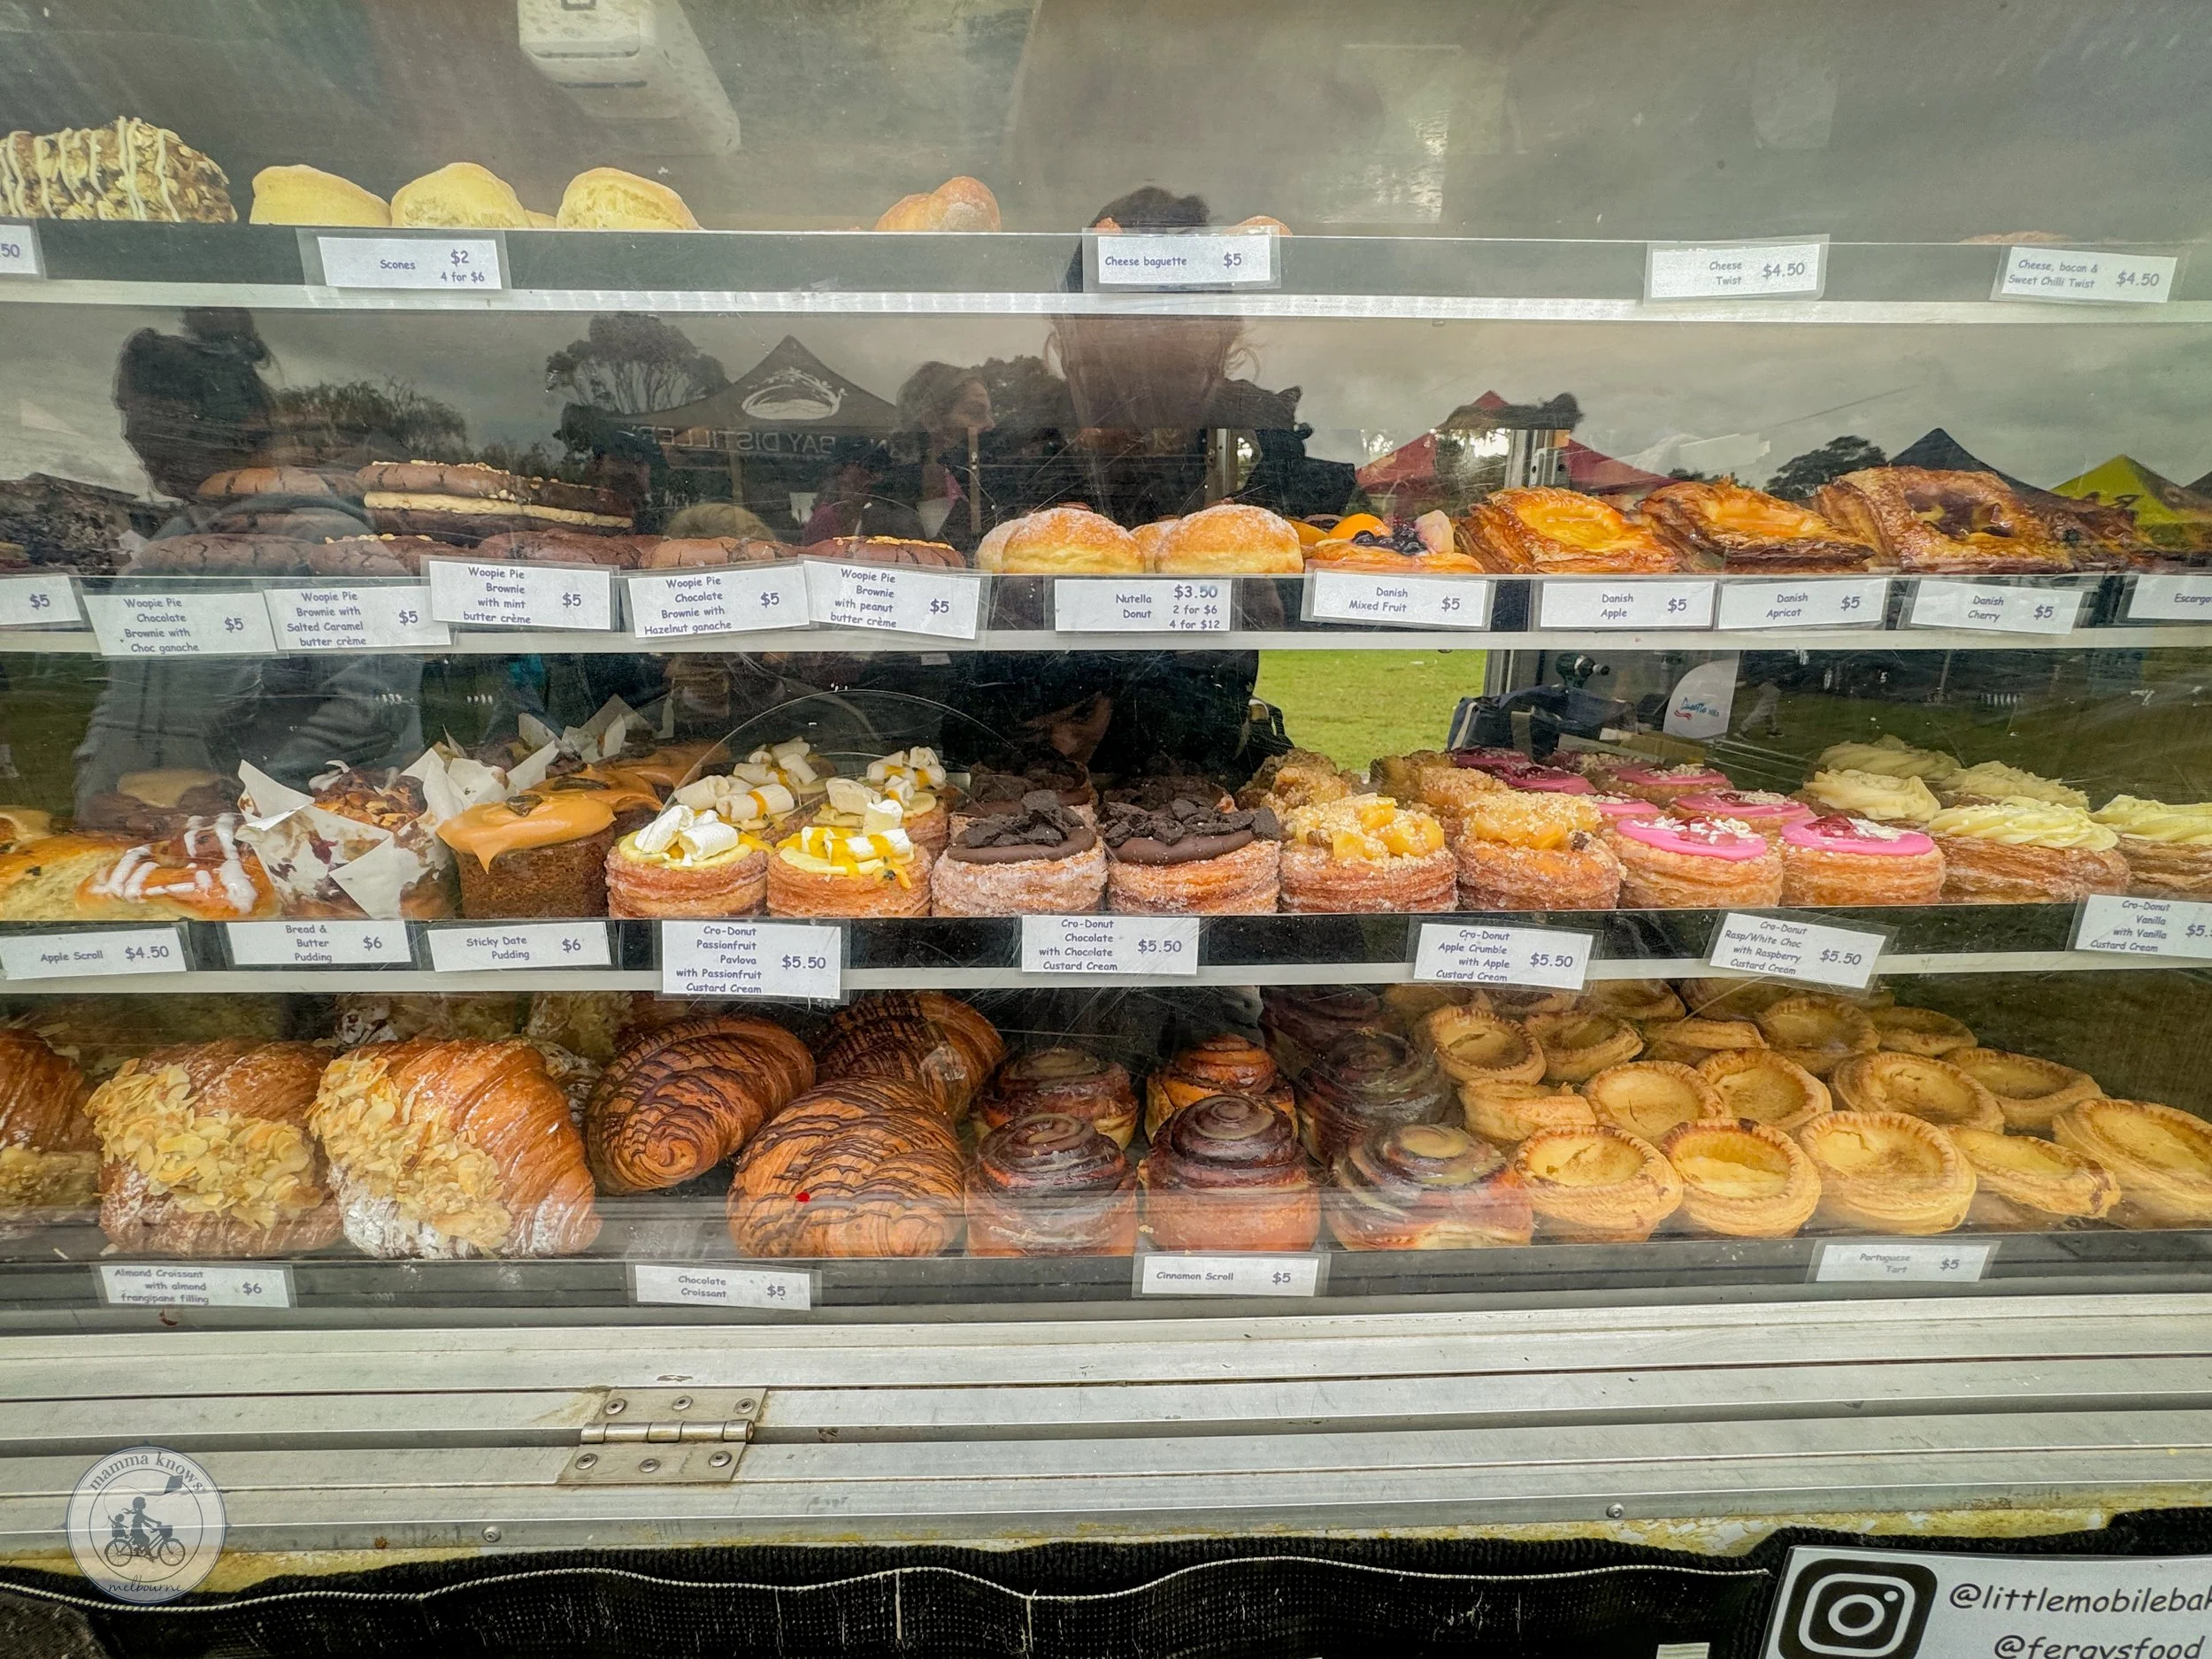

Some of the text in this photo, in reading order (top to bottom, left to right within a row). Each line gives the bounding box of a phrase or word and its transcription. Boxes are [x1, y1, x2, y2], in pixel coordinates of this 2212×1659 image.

[380, 259, 415, 270] Scones
[450, 250, 469, 267] $2
[1105, 256, 1187, 268] Cheese baguette
[1224, 252, 1241, 269] $5
[1709, 261, 1742, 271] Cheese
[1762, 262, 1805, 280] $4.50
[2018, 259, 2098, 273] Cheese, bacon &
[441, 271, 485, 283] 4 for $6
[1716, 276, 1741, 285] Twist
[2008, 274, 2095, 288] Sweet Chilli Twist
[2116, 271, 2159, 287] $4.50
[468, 567, 525, 580] Woopie Pie
[841, 568, 895, 583] Woopie Pie
[487, 582, 525, 594] Brownie
[665, 576, 721, 589] Woopie Pie
[301, 591, 357, 603] Woopie Pie
[675, 591, 723, 603] Chocolate
[856, 585, 894, 597] Brownie
[1174, 584, 1217, 601] $3.50
[1376, 587, 1408, 597] Danish
[29, 594, 50, 610] $5
[123, 597, 182, 610] Woopie Pie
[478, 598, 526, 609] with mint
[563, 592, 581, 608] $5
[761, 592, 780, 608] $5
[1116, 594, 1152, 603] Nutella
[1441, 596, 1460, 612] $5
[1602, 593, 1633, 603] Danish
[1777, 593, 1808, 603] Danish
[1840, 595, 1860, 611] $5
[1972, 595, 2004, 606] Danish
[2174, 593, 2212, 605] Escargo
[835, 598, 894, 612] with peanut
[930, 598, 949, 614] $5
[1173, 604, 1217, 616] 2 for $6
[1349, 600, 1407, 612] Mixed Fruit
[1668, 598, 1686, 613] $5
[137, 613, 187, 622] Chocolate
[296, 606, 361, 617] Brownie with
[464, 611, 531, 624] butter crème
[662, 605, 725, 618] Brownie with
[1124, 609, 1151, 618] Donut
[1601, 608, 1627, 619] Apple
[1766, 609, 1801, 620] Apricot
[1968, 610, 2001, 623] Cherry
[2034, 604, 2054, 619] $5
[399, 610, 418, 626] $5
[831, 611, 896, 627] butter crème
[225, 617, 243, 633] $5
[288, 621, 364, 632] Salted Caramel
[645, 620, 732, 635] Hazelnut ganache
[1180, 619, 1196, 629] for
[1201, 619, 1220, 630] $12
[124, 627, 190, 638] Brownie with
[336, 636, 366, 645] crème
[131, 642, 199, 655] Choc ganache
[2122, 900, 2170, 911] Cro-Donut
[1062, 919, 1114, 928] Cro-Donut
[2137, 915, 2166, 925] Vanilla
[286, 925, 327, 933] Bread &
[703, 926, 757, 936] Cro-Donut
[1760, 921, 1808, 934] Cro-Donut
[2185, 923, 2212, 938] $5.
[1065, 933, 1113, 942] Chocolate
[1460, 930, 1510, 941] Cro-Donut
[1724, 930, 1801, 948] Rasp/White Choc
[2137, 929, 2167, 939] Vanilla
[296, 939, 329, 948] Butter
[364, 936, 382, 951] $6
[466, 937, 498, 948] Sticky
[562, 938, 580, 953] $6
[697, 940, 757, 950] Passionfruit
[1138, 939, 1181, 954] $5.50
[1438, 942, 1507, 954] Apple Crumble
[2090, 940, 2158, 952] Custard Cream
[41, 950, 104, 964] Apple Scroll
[126, 946, 169, 962] $4.50
[492, 950, 530, 960] Pudding
[1040, 947, 1112, 956] with Chocolate
[1733, 946, 1801, 964] with Raspberry
[1820, 949, 1862, 965] $5.50
[295, 953, 332, 964] Pudding
[720, 955, 757, 964] Pavlova
[782, 955, 826, 970] $5.50
[1459, 957, 1509, 970] with Apple
[1530, 952, 1573, 967] $5.50
[1043, 961, 1118, 971] Custard Cream
[1731, 959, 1796, 975] Custard Cream
[676, 968, 762, 979] with Passionfruit
[1436, 970, 1507, 981] Custard Cream
[687, 983, 762, 994] Custard Cream
[1859, 1253, 1910, 1263] Portuguese
[1939, 1258, 1960, 1271] $5
[678, 1276, 726, 1286] Chocolate
[1272, 1271, 1291, 1285] $5
[172, 1282, 206, 1291] almond
[242, 1282, 262, 1295] $6
[681, 1287, 726, 1298] Croissant
[767, 1284, 786, 1298] $5
[120, 1293, 209, 1305] frangipane filling
